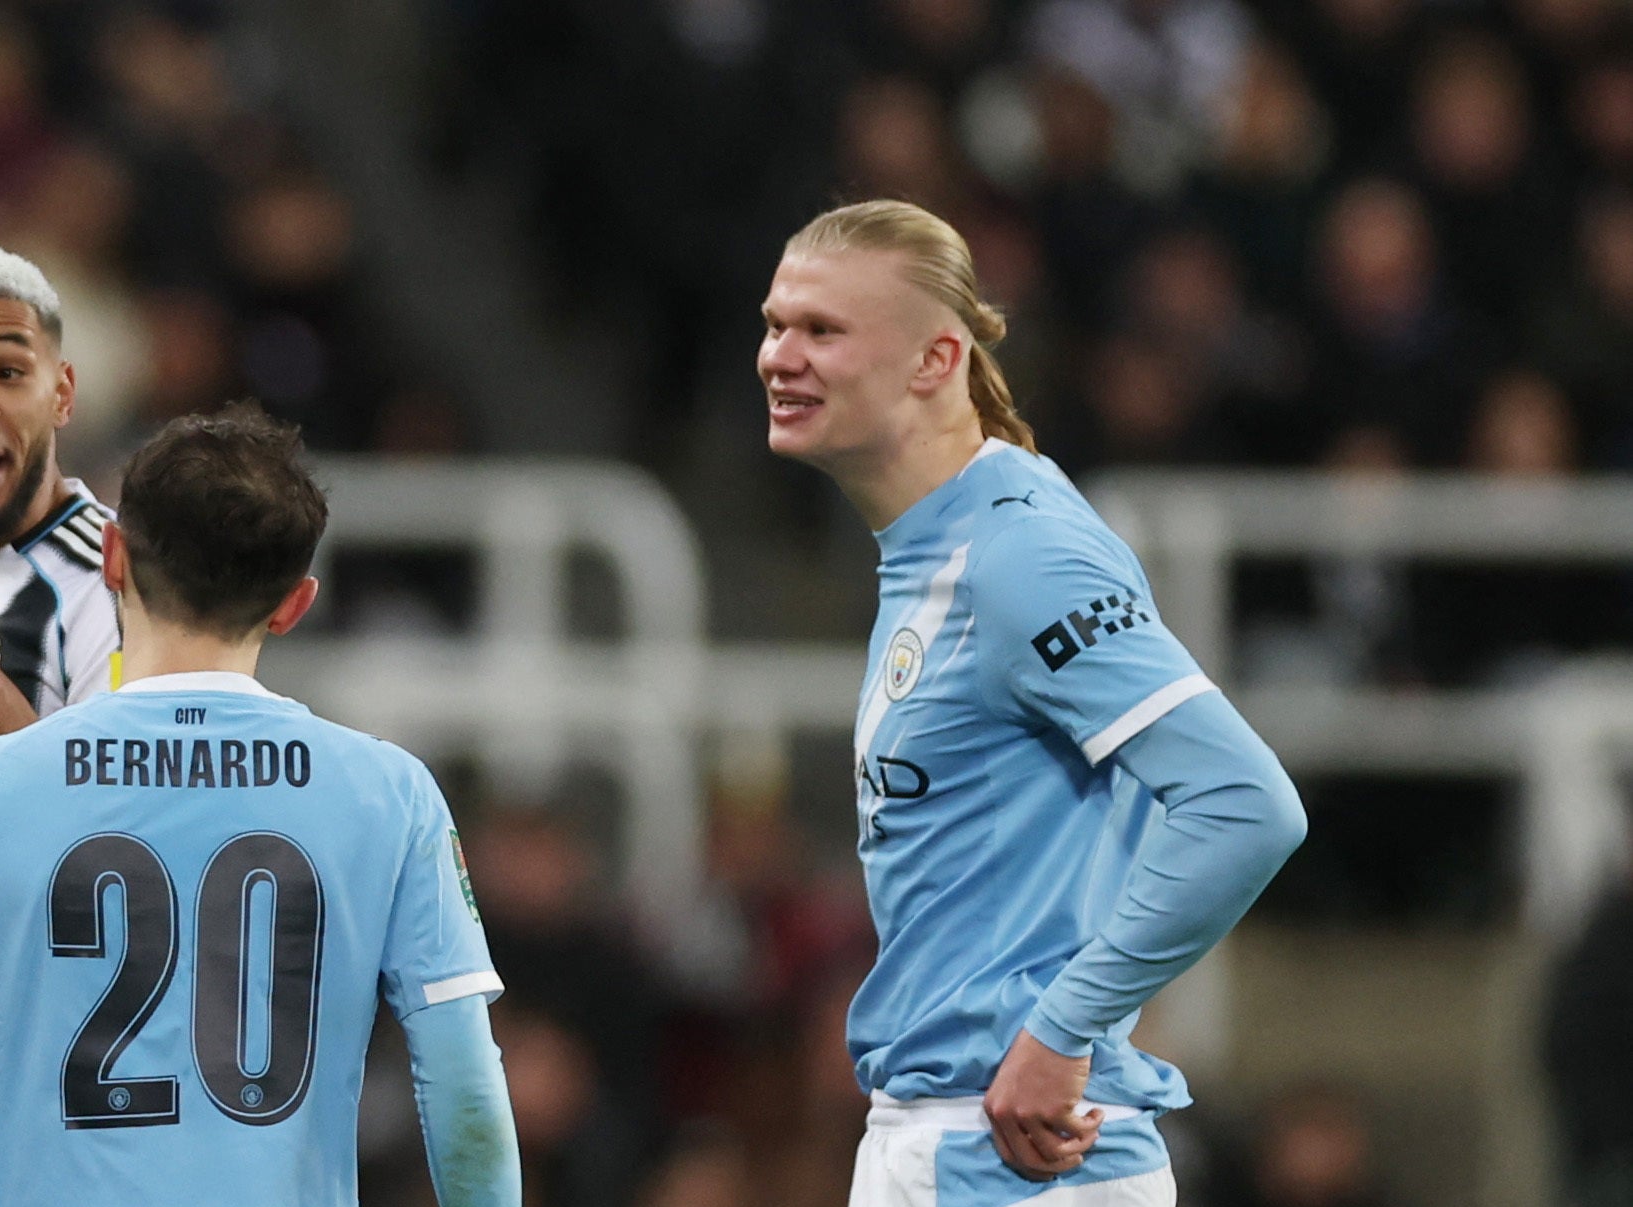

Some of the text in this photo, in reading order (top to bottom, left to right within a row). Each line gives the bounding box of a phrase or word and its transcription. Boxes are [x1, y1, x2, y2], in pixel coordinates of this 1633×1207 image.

[175, 707, 207, 725] CITY
[65, 738, 311, 788] BERNARDO
[47, 829, 326, 1130] 20
